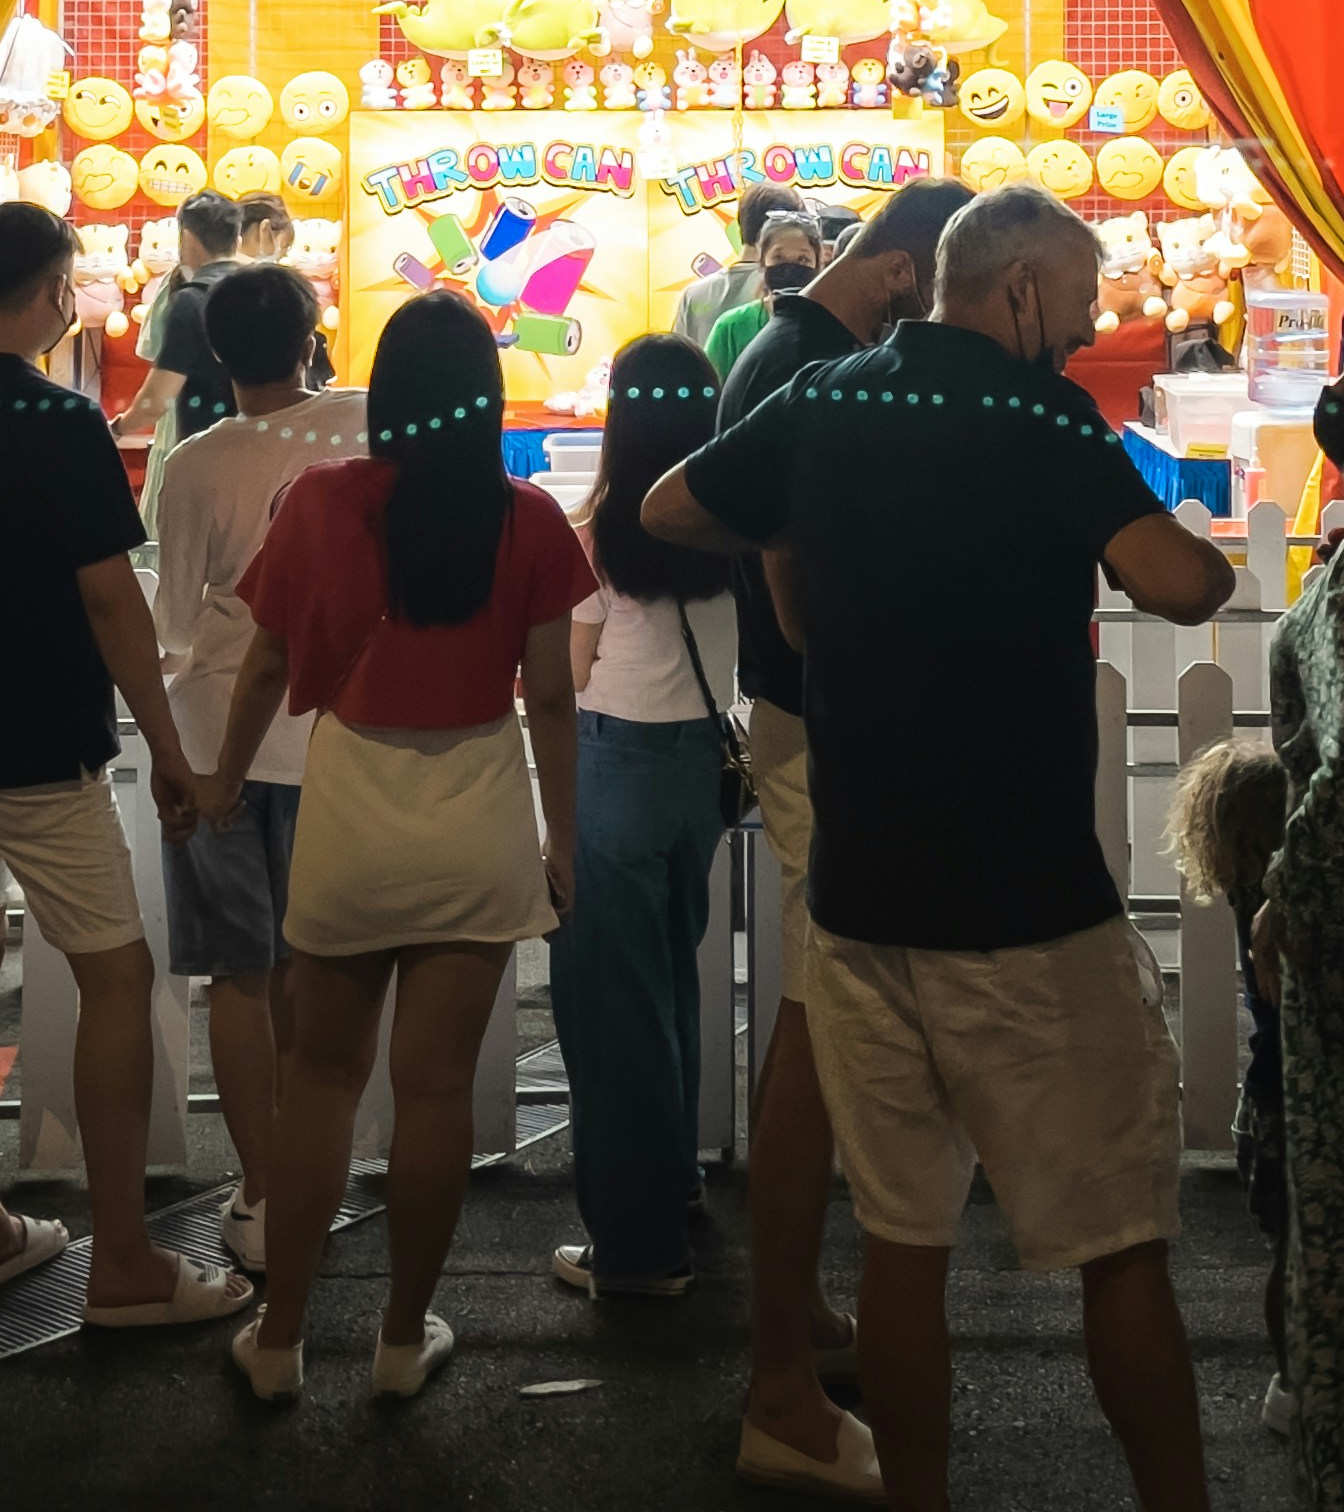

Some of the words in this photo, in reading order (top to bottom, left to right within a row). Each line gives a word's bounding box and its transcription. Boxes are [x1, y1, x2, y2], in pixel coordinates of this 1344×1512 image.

[365, 140, 537, 209] THROW
[544, 140, 635, 192] CAN
[665, 141, 835, 209] THROW
[840, 141, 930, 186] CAN
